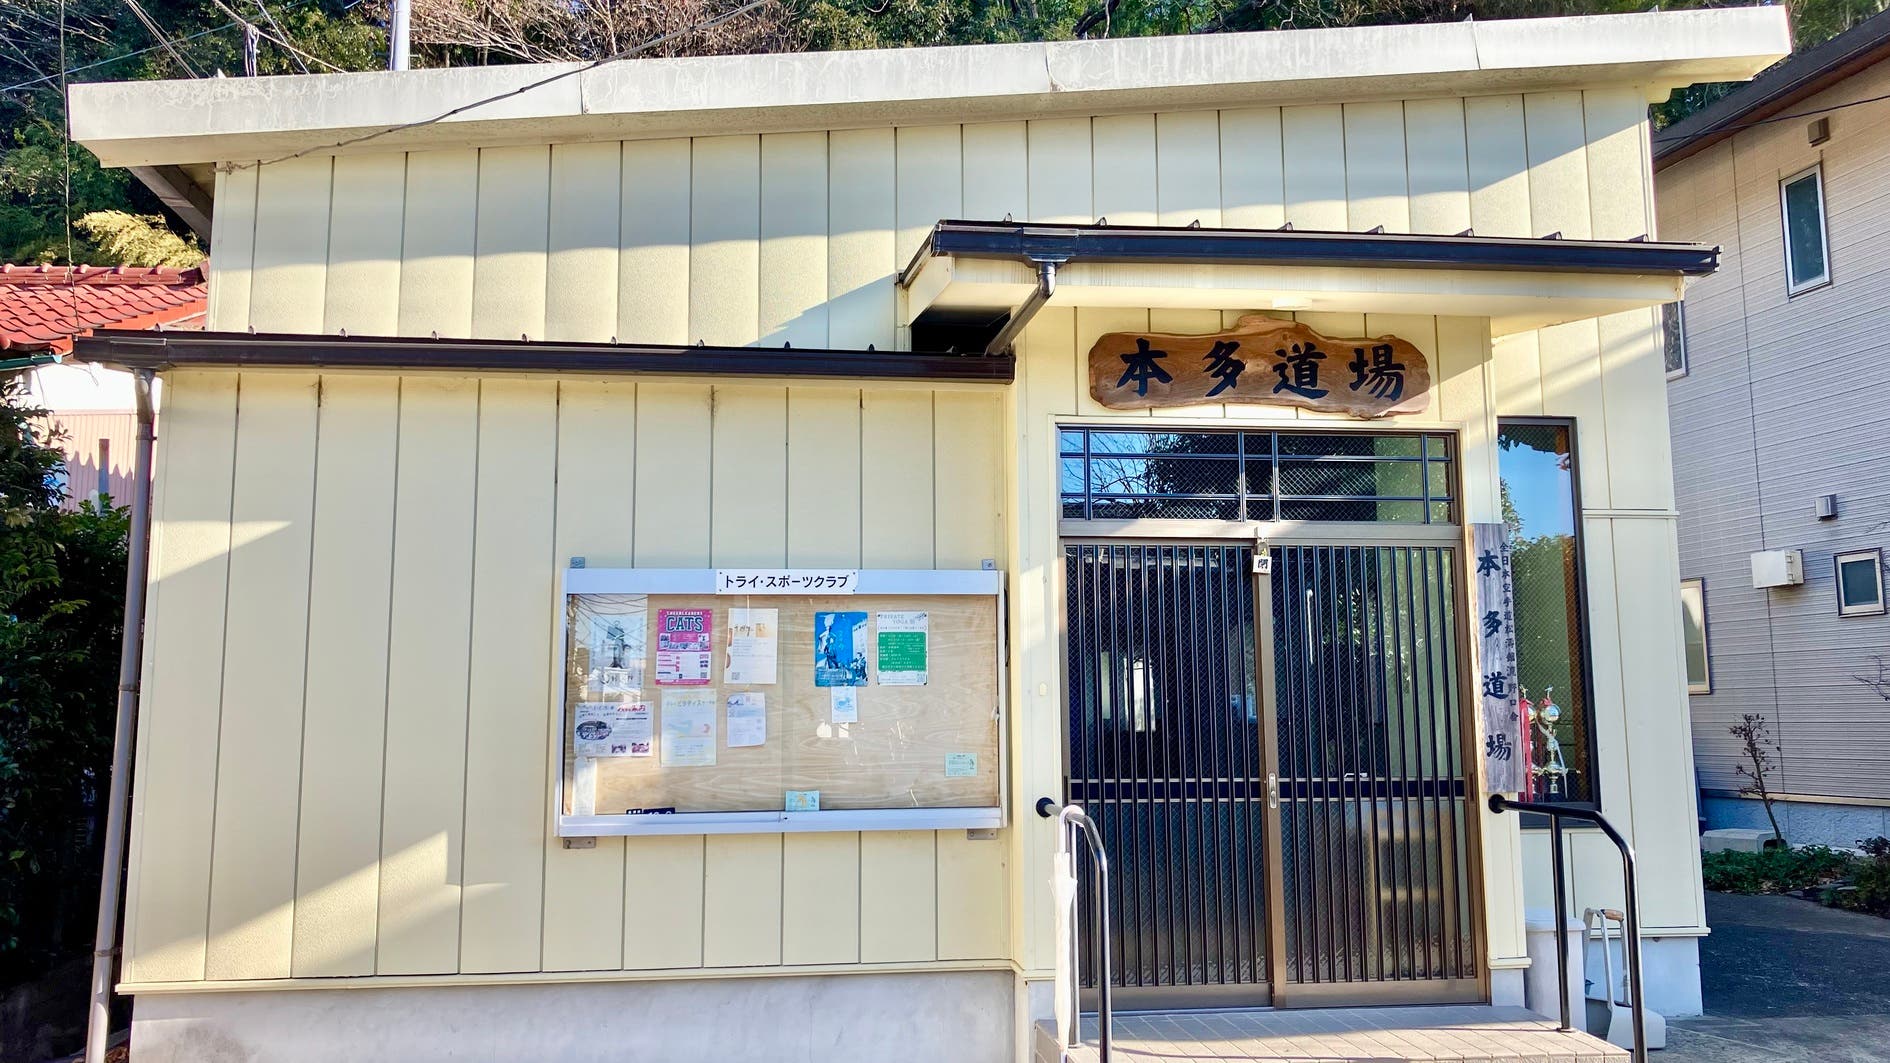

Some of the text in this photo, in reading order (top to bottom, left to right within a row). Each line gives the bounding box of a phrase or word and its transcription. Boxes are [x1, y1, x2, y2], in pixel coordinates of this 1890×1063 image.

[1116, 337, 1406, 401] 本多道場
[725, 574, 849, 588] トライ・スポーツクラブ
[666, 615, 704, 633] CATS
[1476, 549, 1512, 761] 本多道場
